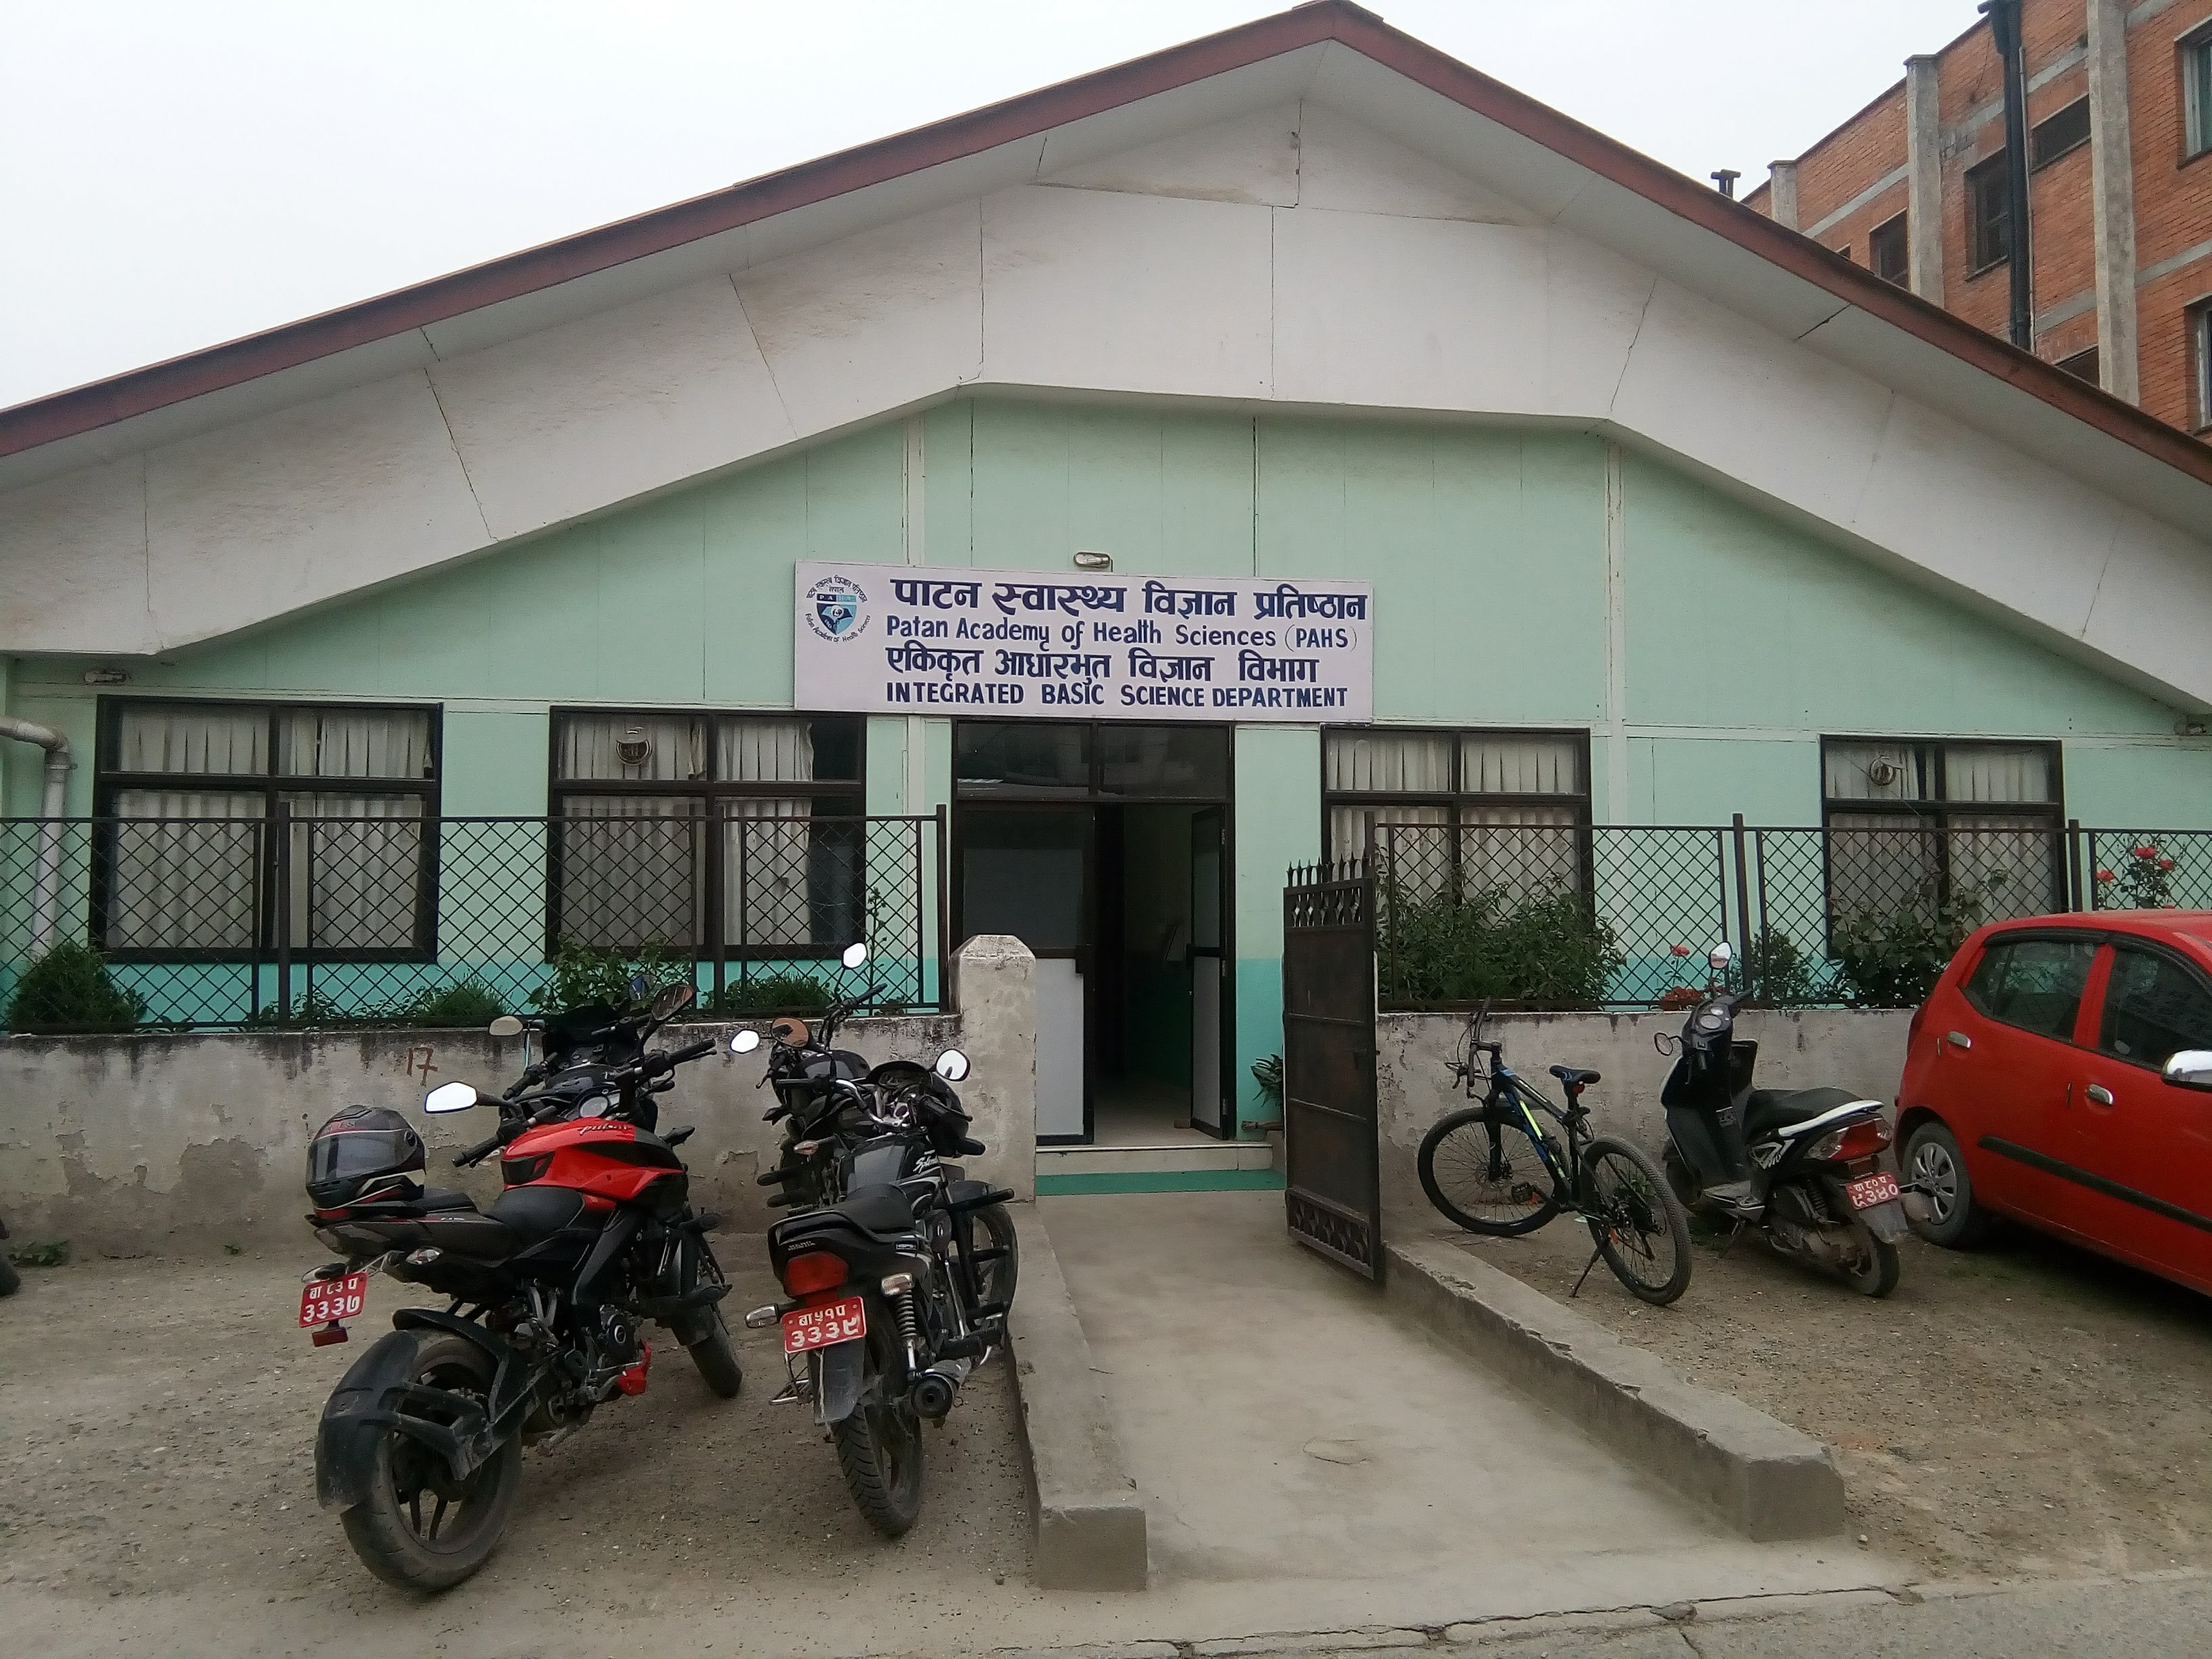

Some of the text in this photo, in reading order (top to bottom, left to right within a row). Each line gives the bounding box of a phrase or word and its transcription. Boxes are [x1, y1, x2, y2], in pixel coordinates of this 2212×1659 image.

[890, 579, 1368, 620] पाटन स्वास्थ्य विज्ञान प्रतिष्ठान
[887, 615, 1357, 653] Patan Academy of Health Sciences (PAHS)
[885, 640, 984, 681] एकिकृत
[1128, 647, 1215, 682] विज्ञान
[1238, 649, 1319, 682] विभाग
[886, 682, 1347, 708] INTEGRATED BASIC SCIENCE DEPARTMENT
[407, 1047, 438, 1087] 17
[303, 1295, 360, 1322] ३३३७
